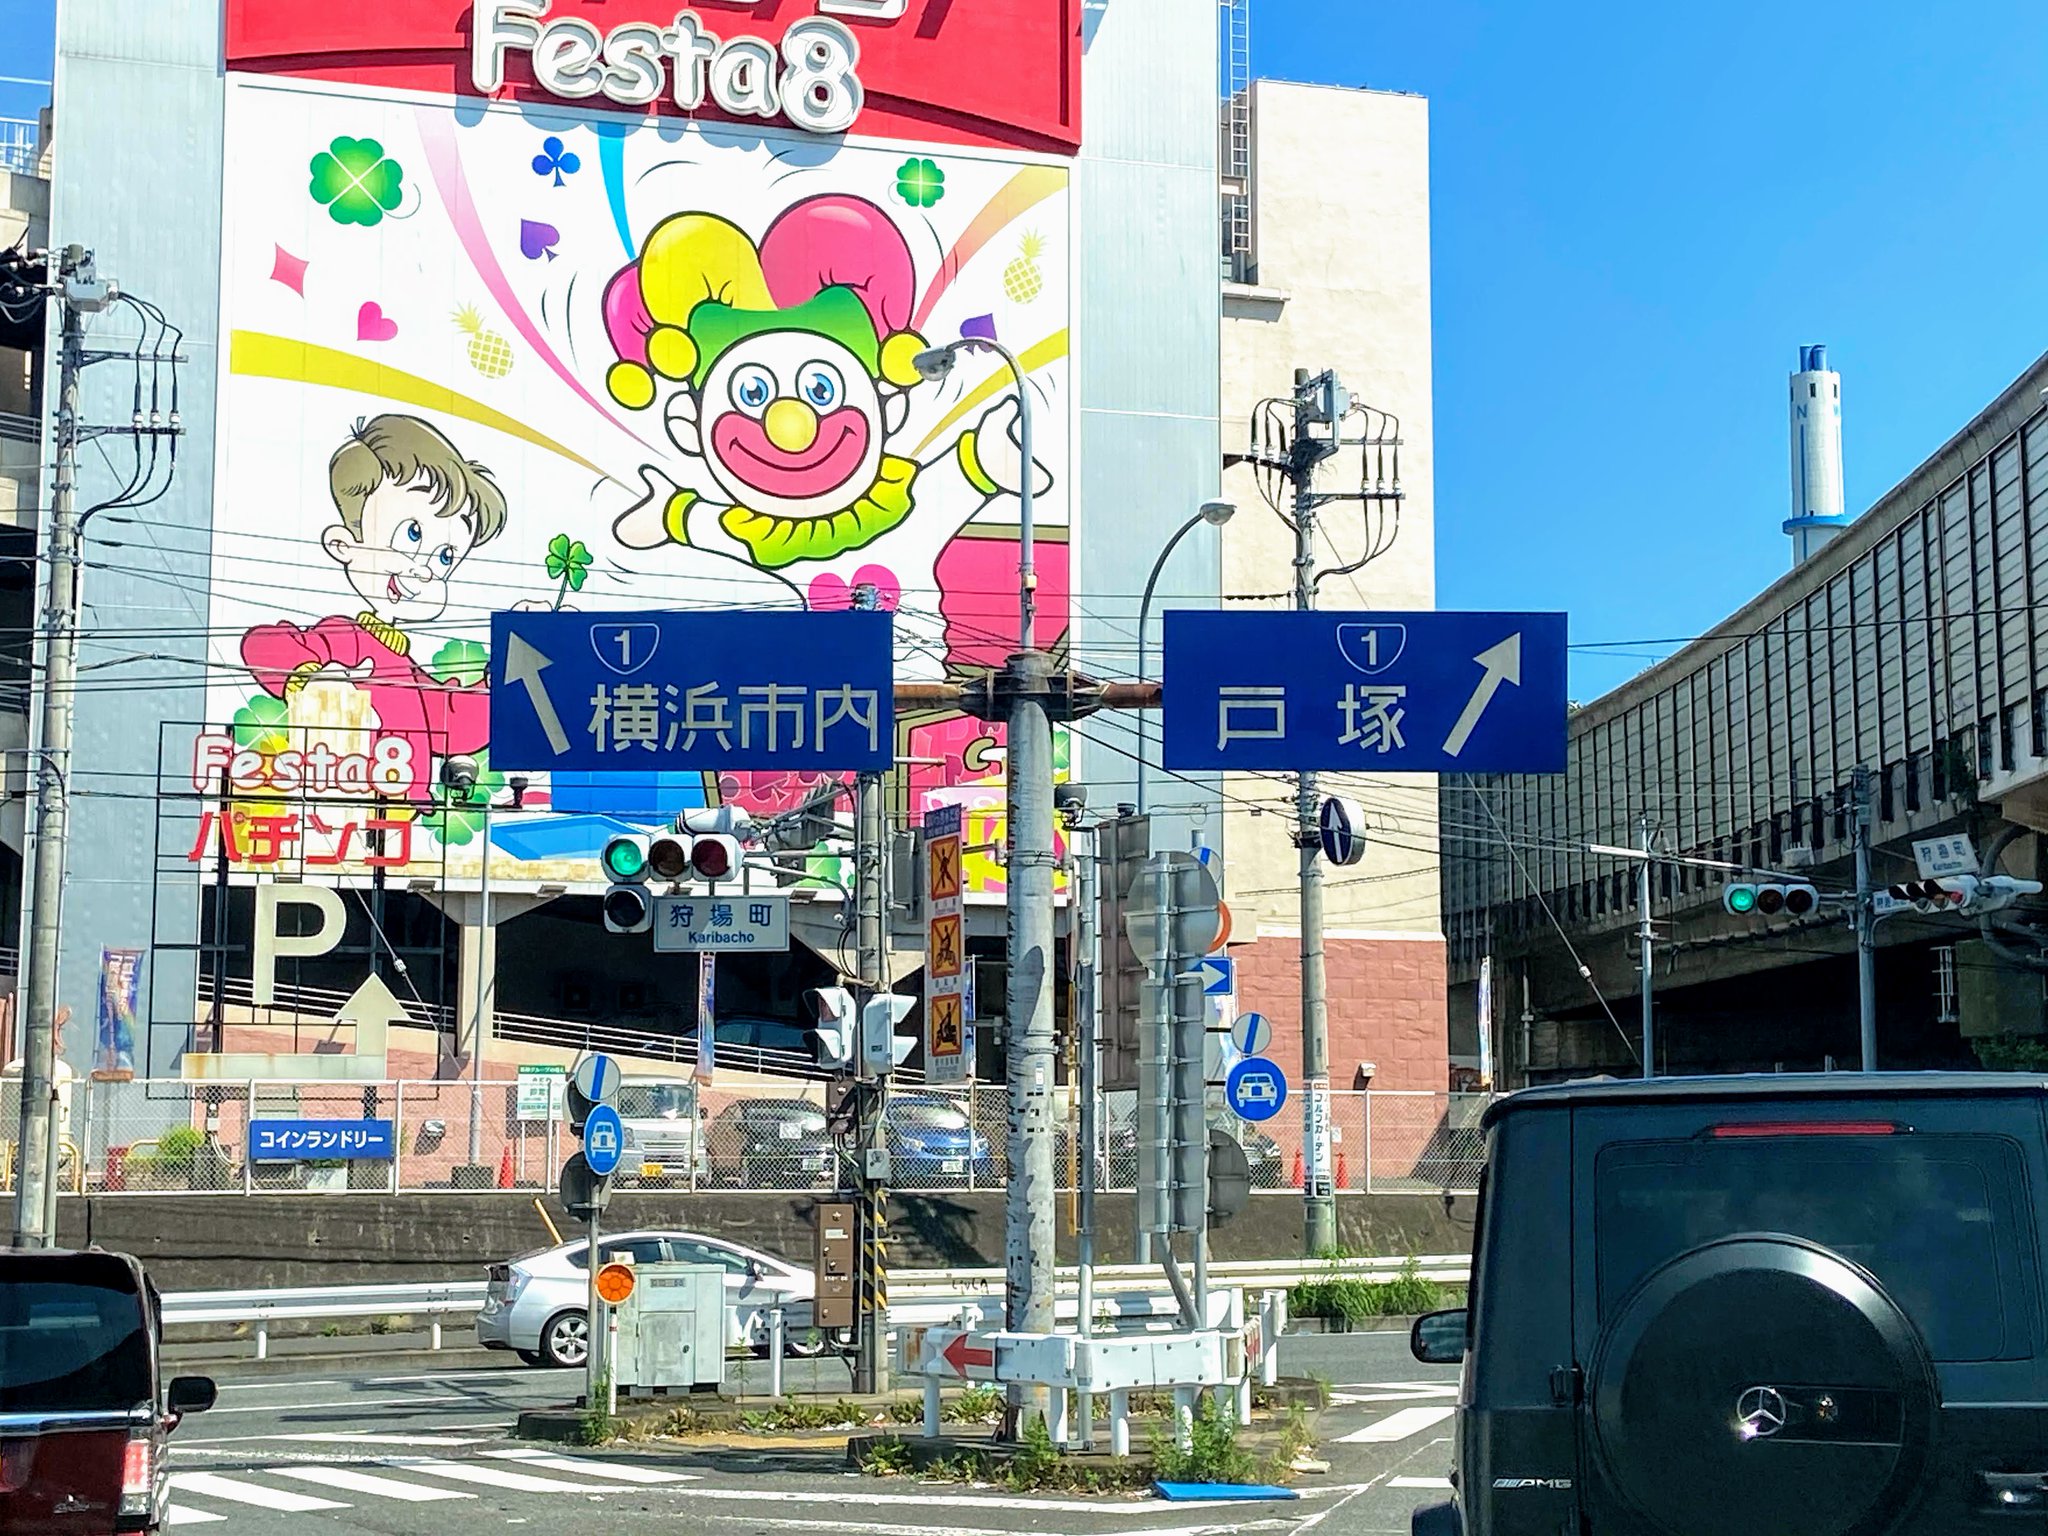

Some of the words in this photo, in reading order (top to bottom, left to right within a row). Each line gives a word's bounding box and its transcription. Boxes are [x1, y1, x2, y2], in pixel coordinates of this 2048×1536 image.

[472, 0, 865, 133] Festa8
[614, 630, 631, 665] 1
[1360, 630, 1377, 665] 1
[588, 682, 879, 752] 横浜市内
[1217, 684, 1407, 753] 戸塚
[193, 734, 414, 796] Festa8
[188, 811, 412, 867] パチンコ
[670, 904, 772, 928] 狩場町
[688, 931, 755, 943] Karibacho
[253, 883, 347, 1004] P
[259, 1131, 384, 1149] コインランドリー
[1519, 1479, 1572, 1488] AMG
